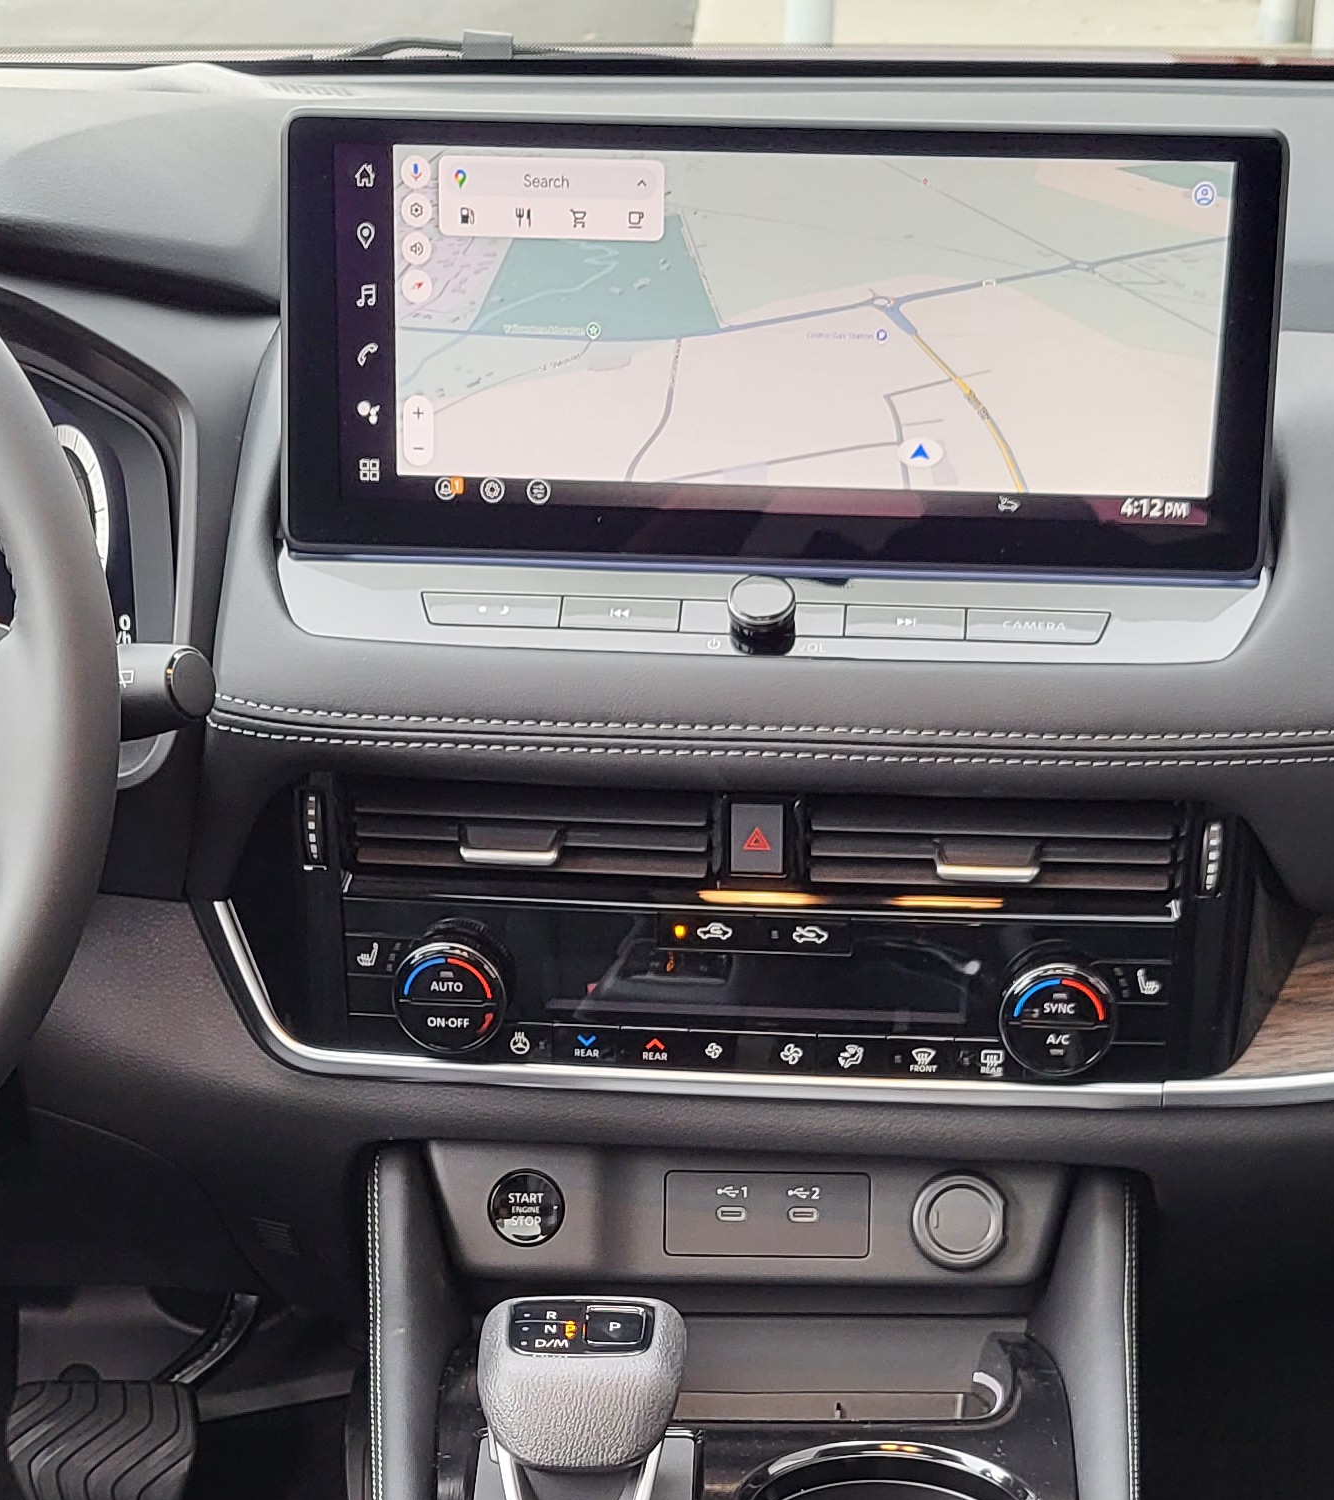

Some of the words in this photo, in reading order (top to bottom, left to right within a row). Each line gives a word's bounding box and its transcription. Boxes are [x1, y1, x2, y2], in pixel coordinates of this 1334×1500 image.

[523, 173, 570, 189] Search
[118, 613, 131, 631] 0
[1002, 620, 1067, 631] CAMERA
[797, 643, 827, 653] VOL
[430, 980, 464, 993] AUTO
[1043, 1002, 1076, 1014] SYNC
[1045, 1033, 1071, 1045] A/C
[573, 1048, 600, 1058] REAR
[642, 1051, 668, 1061] REAR
[909, 1064, 938, 1074] FRONT
[980, 1066, 1003, 1075] REAR
[507, 1192, 545, 1204] START
[740, 1186, 748, 1199] 1
[810, 1187, 821, 1200] 2
[511, 1205, 541, 1214] ENGINE
[510, 1215, 542, 1227] STOP
[545, 1310, 558, 1320] R
[544, 1324, 557, 1334] N
[608, 1321, 622, 1332] P
[534, 1338, 570, 1349] D/M
